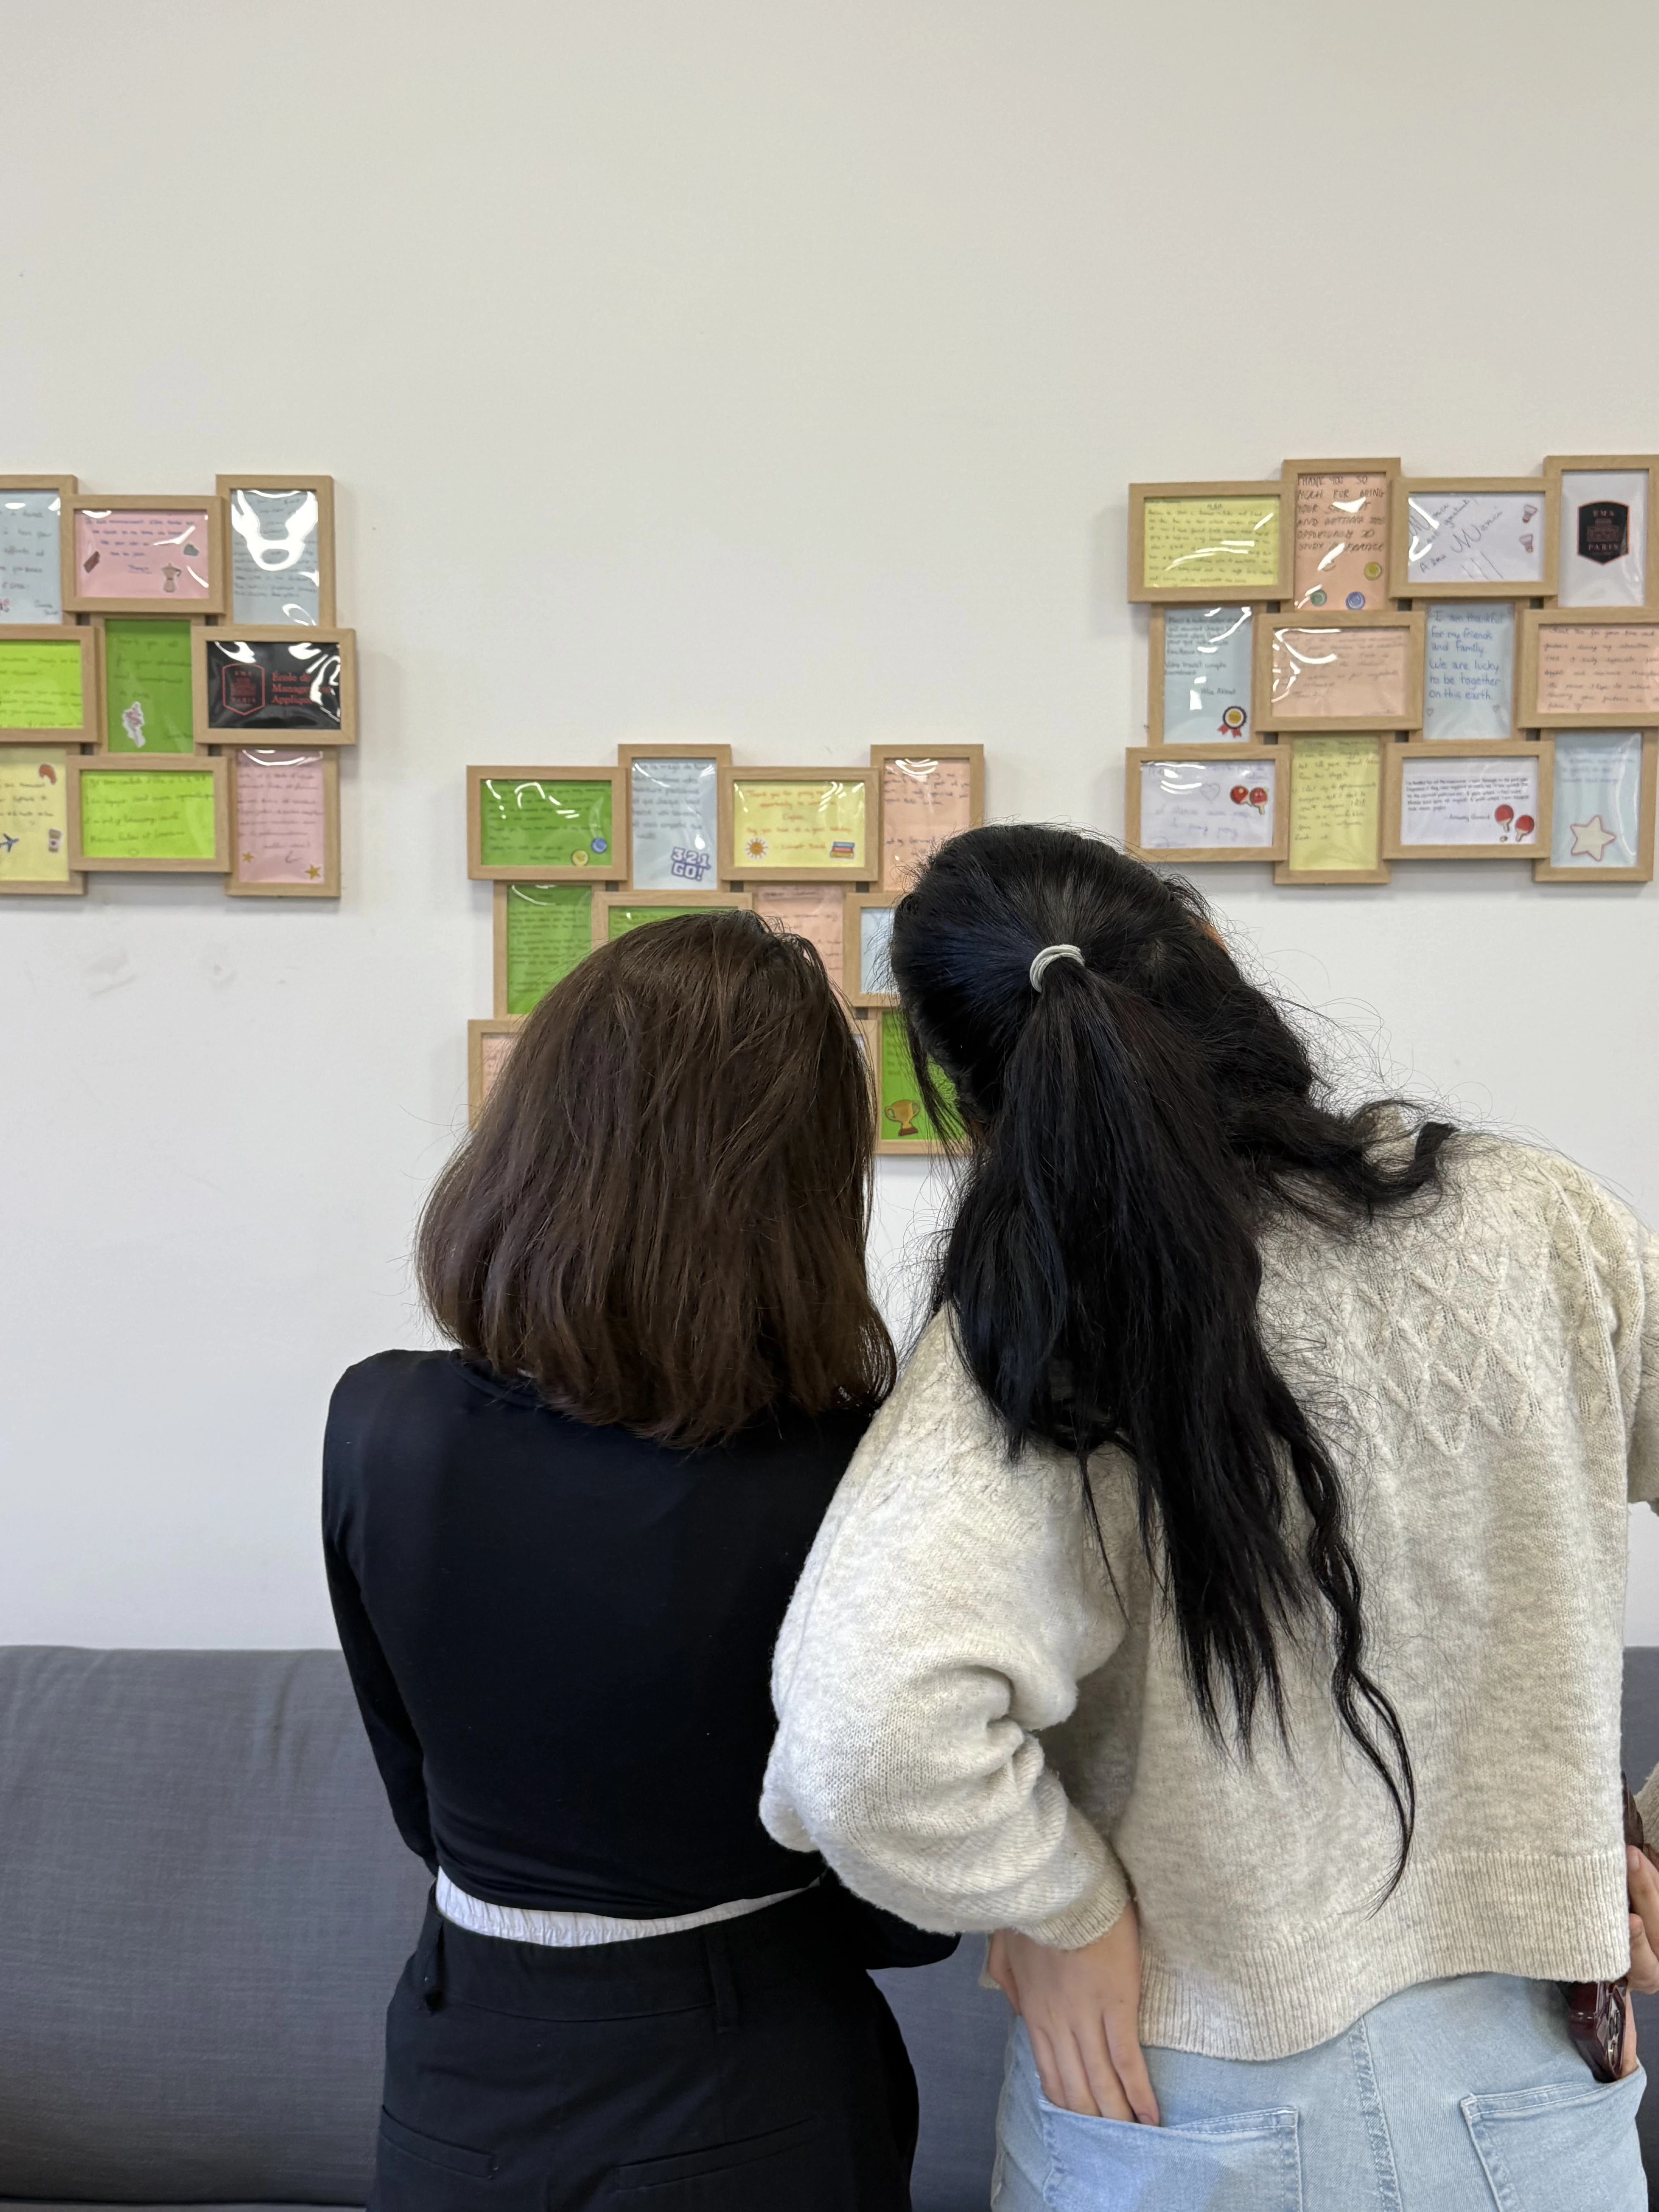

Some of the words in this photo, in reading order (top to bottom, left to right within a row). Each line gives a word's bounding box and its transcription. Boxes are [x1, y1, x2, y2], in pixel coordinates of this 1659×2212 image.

[1333, 489, 1350, 498] FOR
[1467, 612, 1503, 624] thankful
[1431, 642, 1449, 651] and
[1429, 657, 1447, 670] We
[1453, 661, 1469, 670] are
[1474, 659, 1499, 675] lucky
[1429, 672, 1439, 684] to
[1443, 673, 1455, 685] be
[1460, 672, 1501, 690] together
[1444, 687, 1462, 699] this
[1465, 689, 1491, 700] earth
[673, 863, 703, 880] GO!
